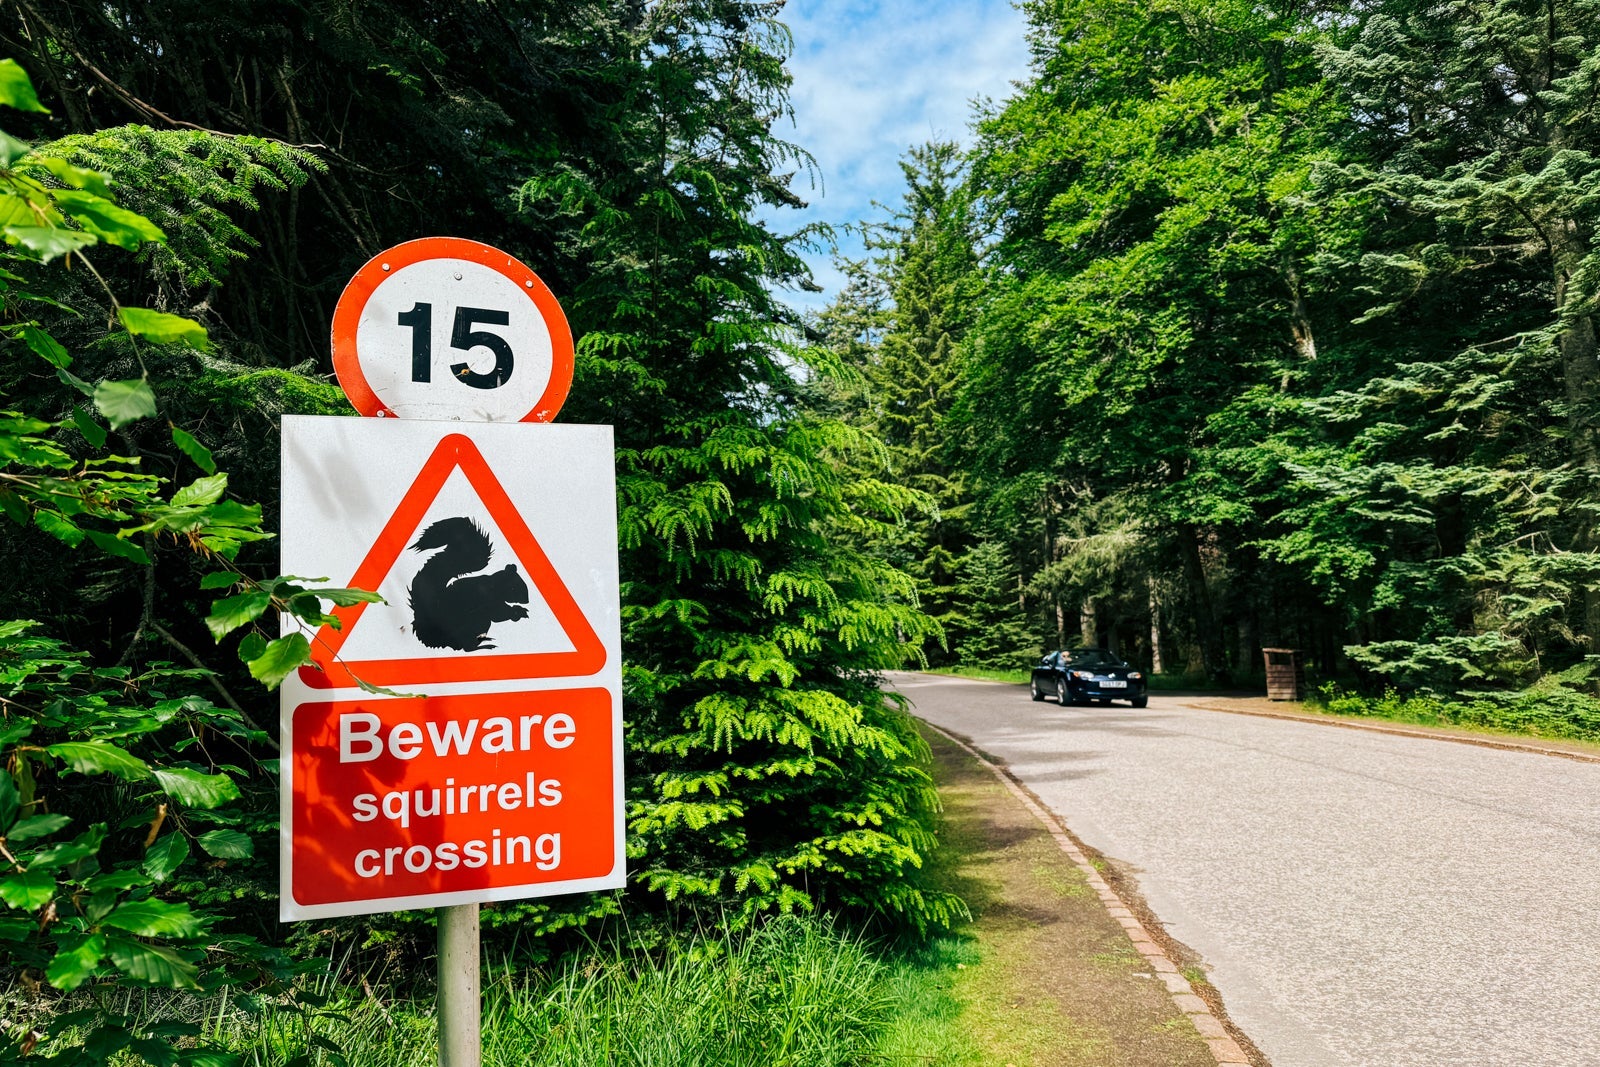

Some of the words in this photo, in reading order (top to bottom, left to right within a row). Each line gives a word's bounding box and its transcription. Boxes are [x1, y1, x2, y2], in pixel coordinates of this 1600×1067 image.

[398, 301, 515, 390] 15
[339, 712, 576, 763] Beware
[352, 772, 563, 828] squirrels
[354, 829, 561, 878] crossing
